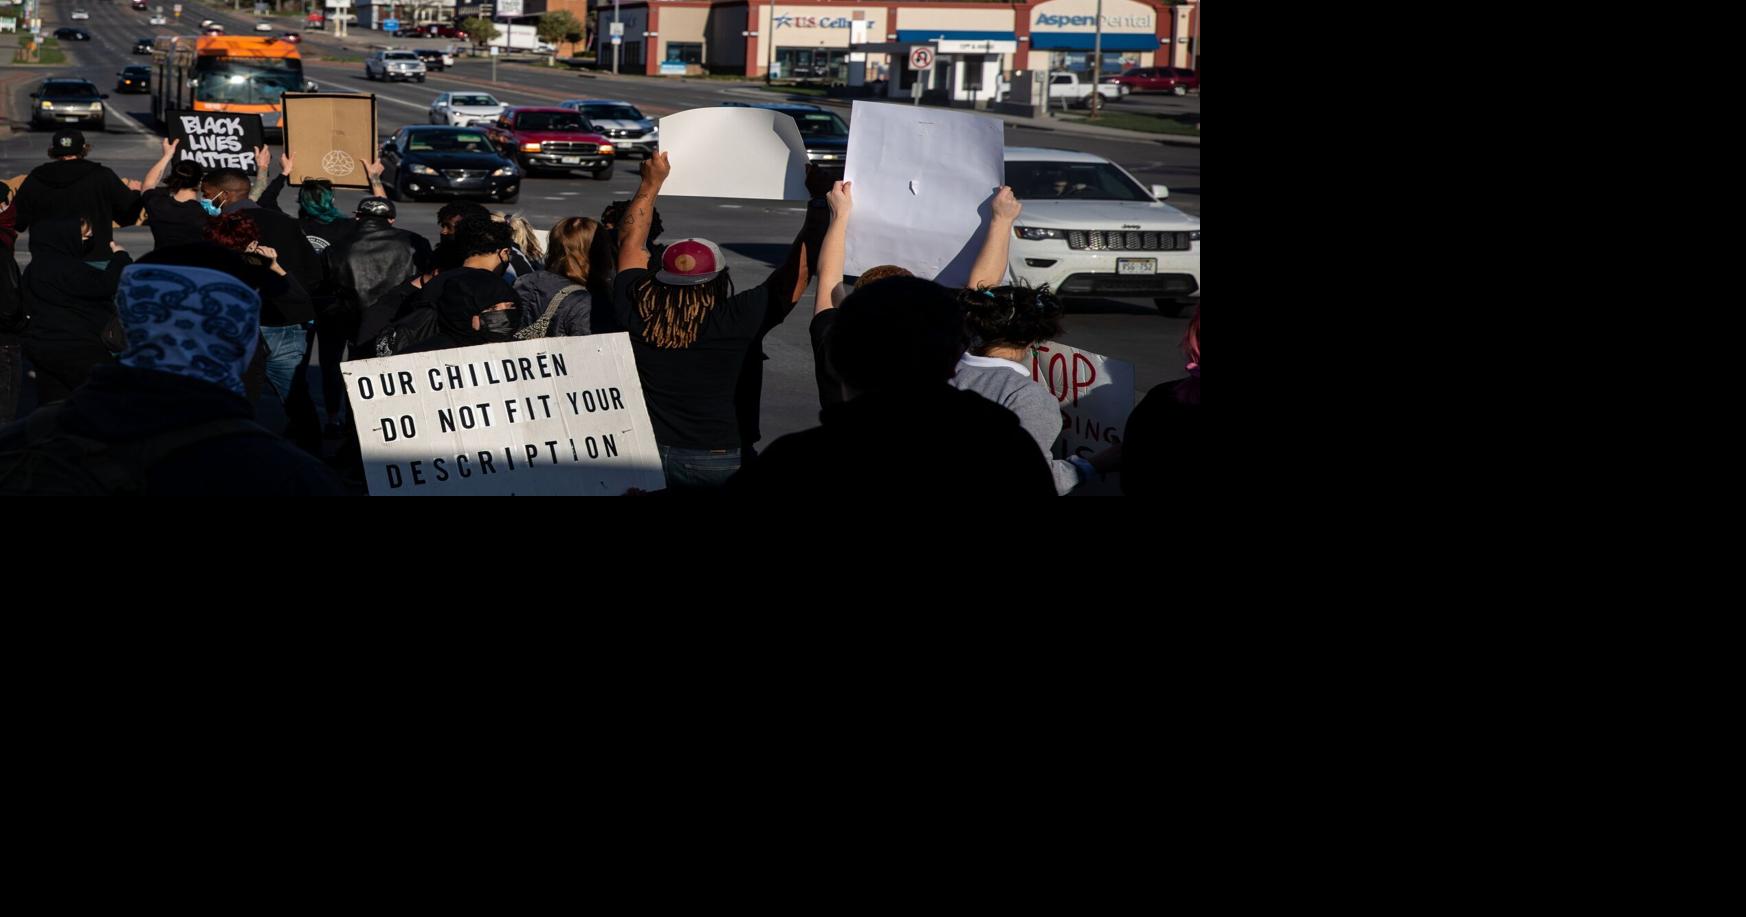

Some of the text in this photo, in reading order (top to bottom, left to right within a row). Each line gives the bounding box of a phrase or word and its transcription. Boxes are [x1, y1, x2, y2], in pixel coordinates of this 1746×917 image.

[820, 16, 875, 29] Cellr
[180, 115, 244, 136] BLACK
[189, 134, 242, 151] LIVES
[181, 149, 256, 171] MATTER
[358, 353, 568, 400] OUR CHILDREN
[1030, 345, 1096, 408] TOP
[381, 387, 625, 442] DO NOT FIT YOUR
[386, 434, 619, 488] DESCRIPTION
